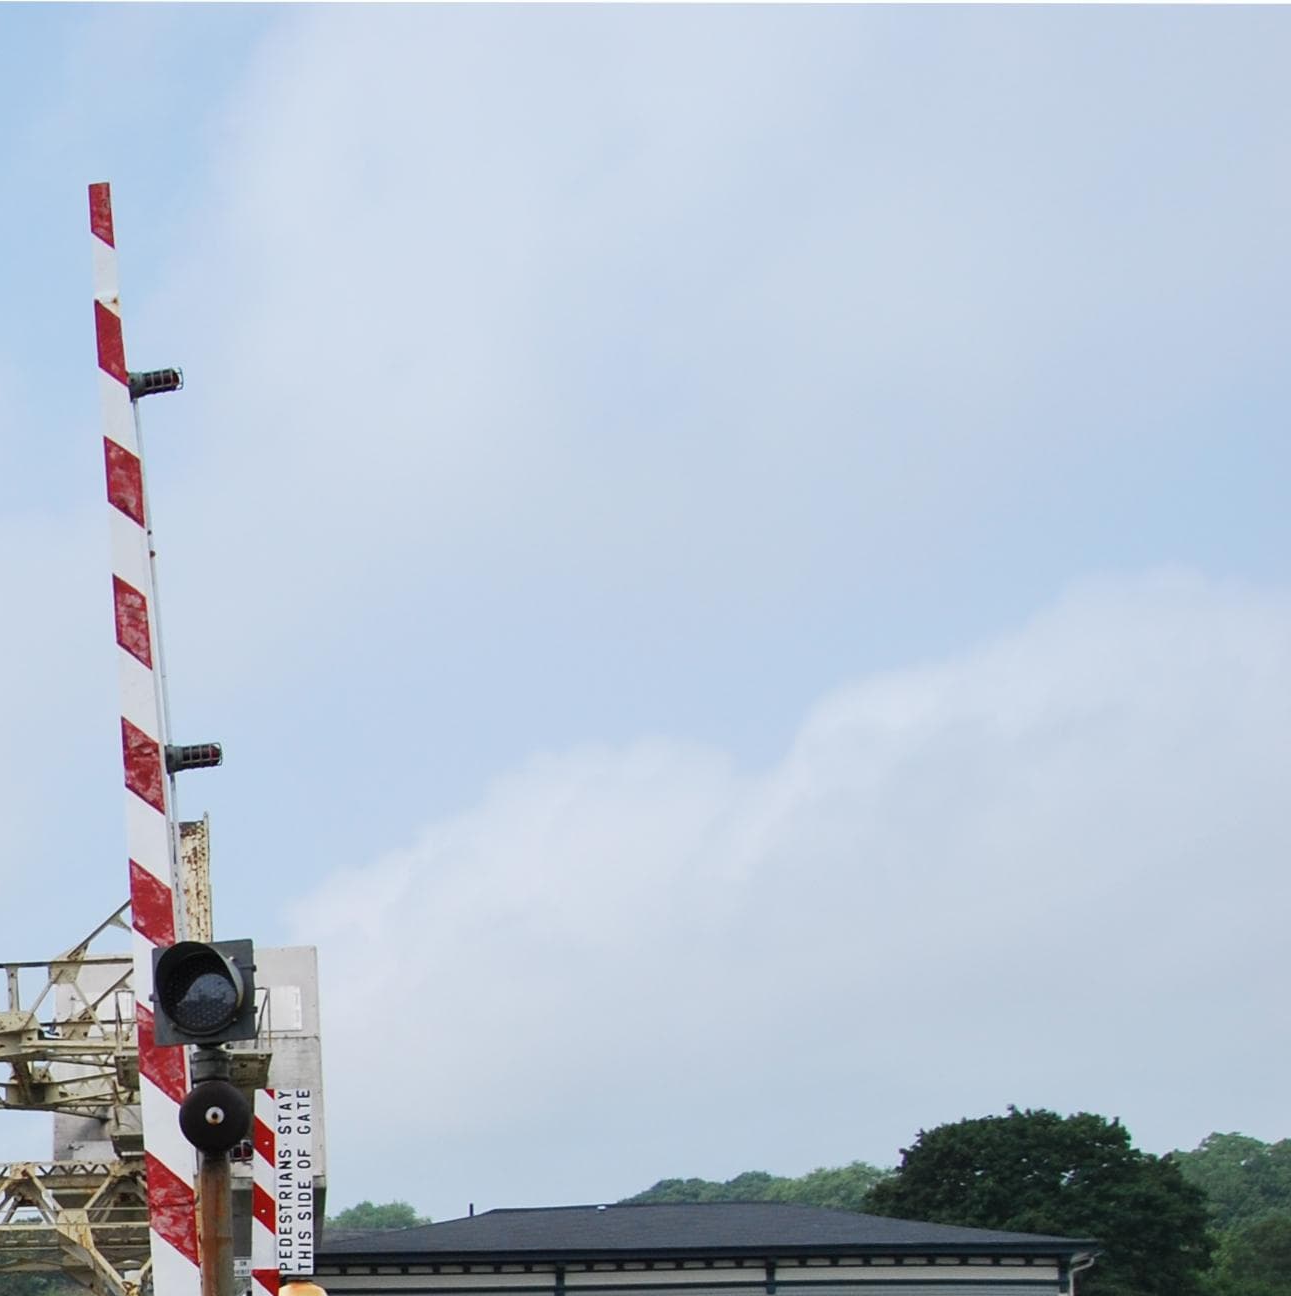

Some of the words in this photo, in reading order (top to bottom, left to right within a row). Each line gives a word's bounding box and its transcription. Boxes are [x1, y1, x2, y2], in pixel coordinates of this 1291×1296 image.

[277, 1090, 292, 1134] STAY
[296, 1089, 311, 1135] GATE
[297, 1148, 311, 1169] OF
[278, 1149, 293, 1271] PEDESTRIANS
[297, 1180, 311, 1220] SIDE
[297, 1229, 311, 1271] THIS
